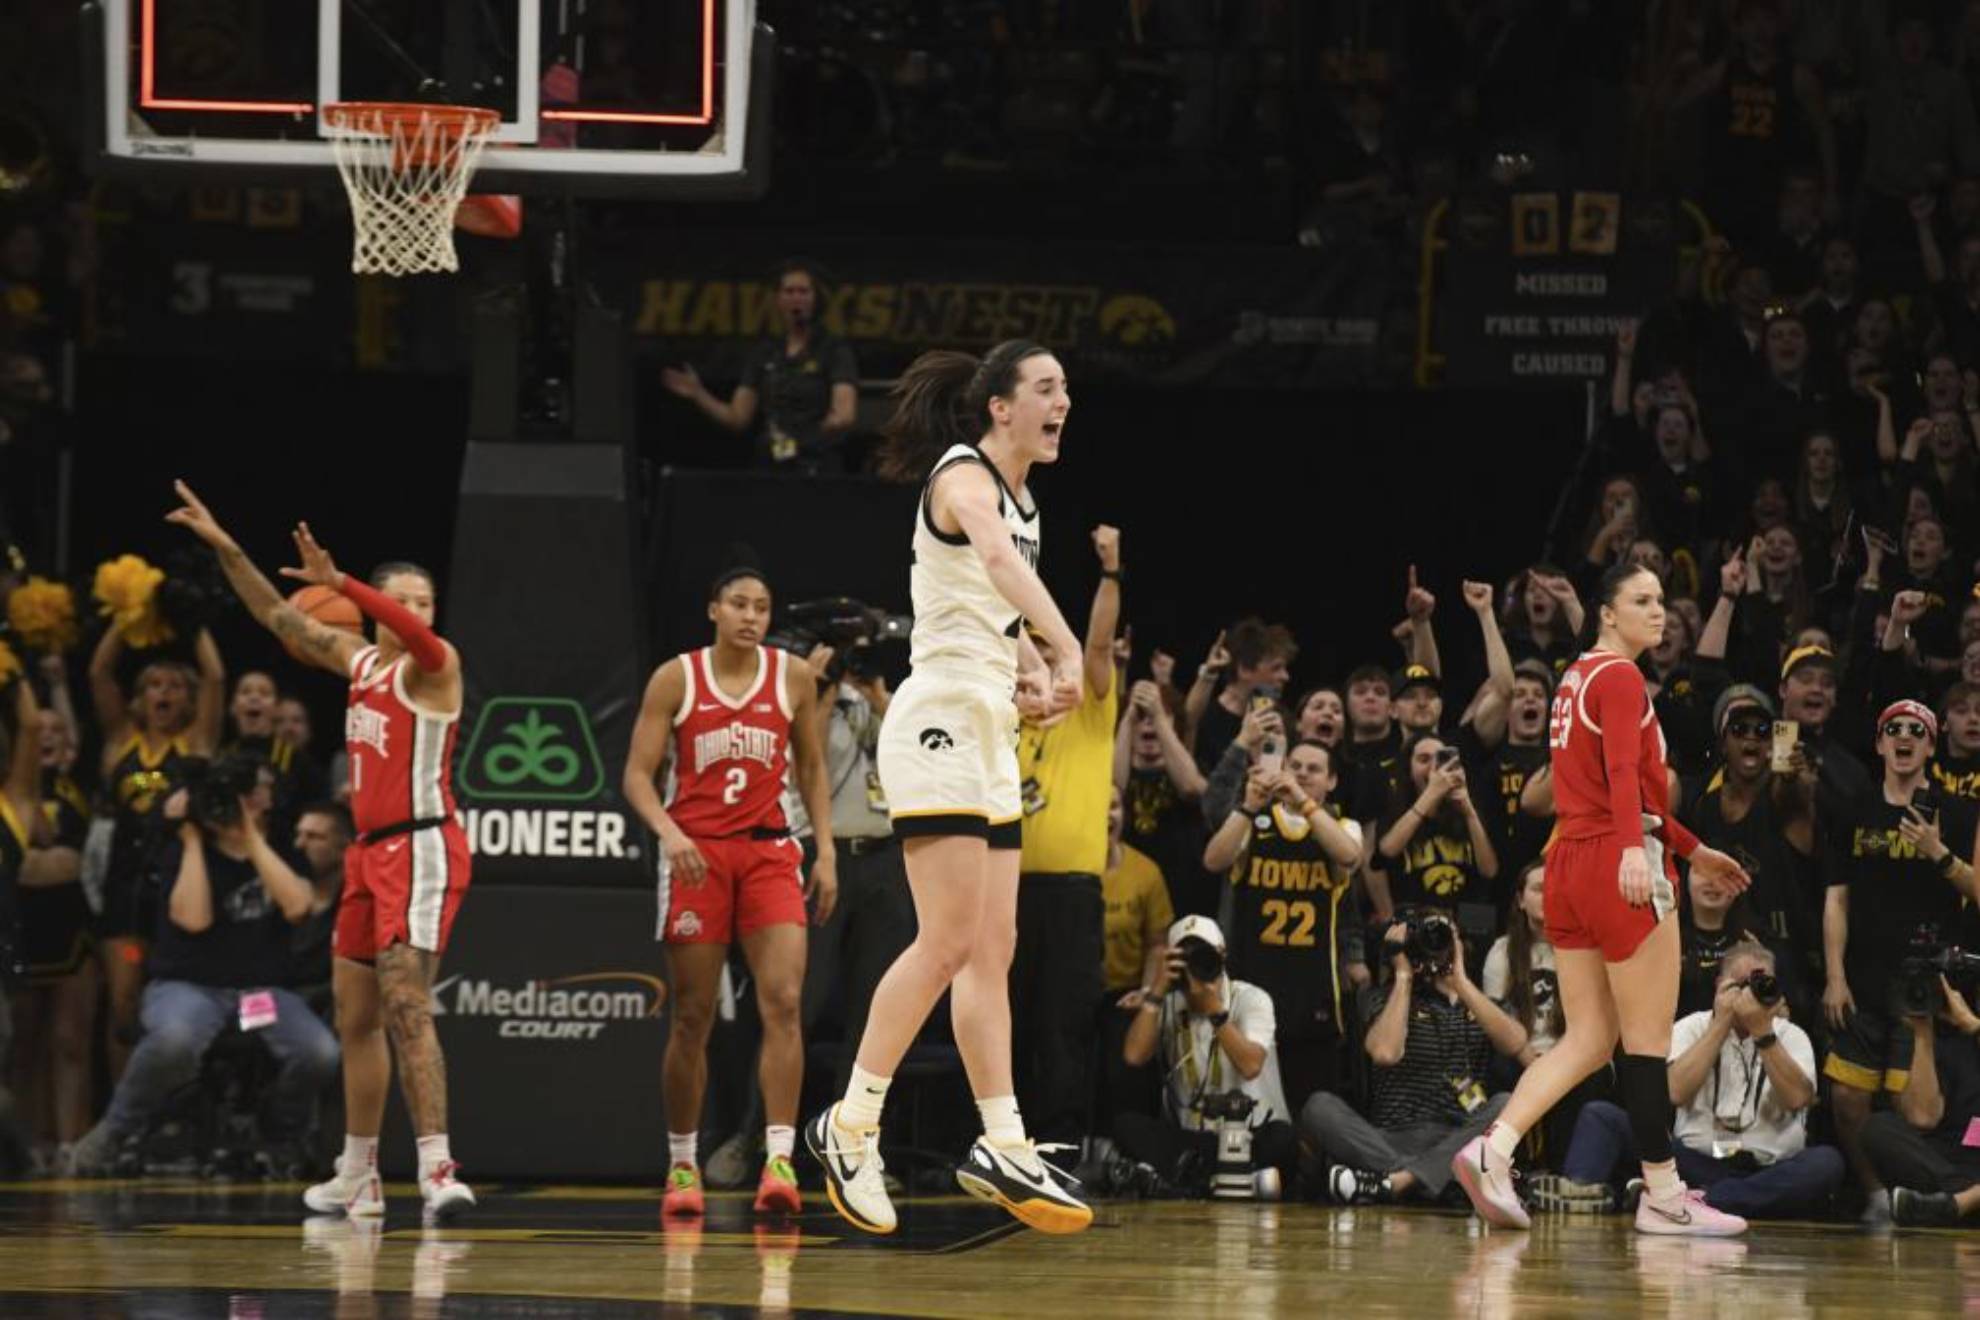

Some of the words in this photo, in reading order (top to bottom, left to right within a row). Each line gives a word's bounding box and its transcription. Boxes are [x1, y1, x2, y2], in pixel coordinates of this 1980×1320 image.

[173, 261, 213, 314] 3
[1515, 273, 1607, 295] MISSED
[1484, 315, 1540, 335] FREE
[1547, 315, 1628, 335] THROW
[1512, 353, 1606, 375] CAUSED
[353, 753, 362, 792] 1
[724, 767, 747, 804] 2
[1249, 857, 1332, 891] IOWA
[1260, 900, 1316, 945] 22
[456, 979, 646, 1018] Mediacom
[499, 1020, 606, 1039] COURT
